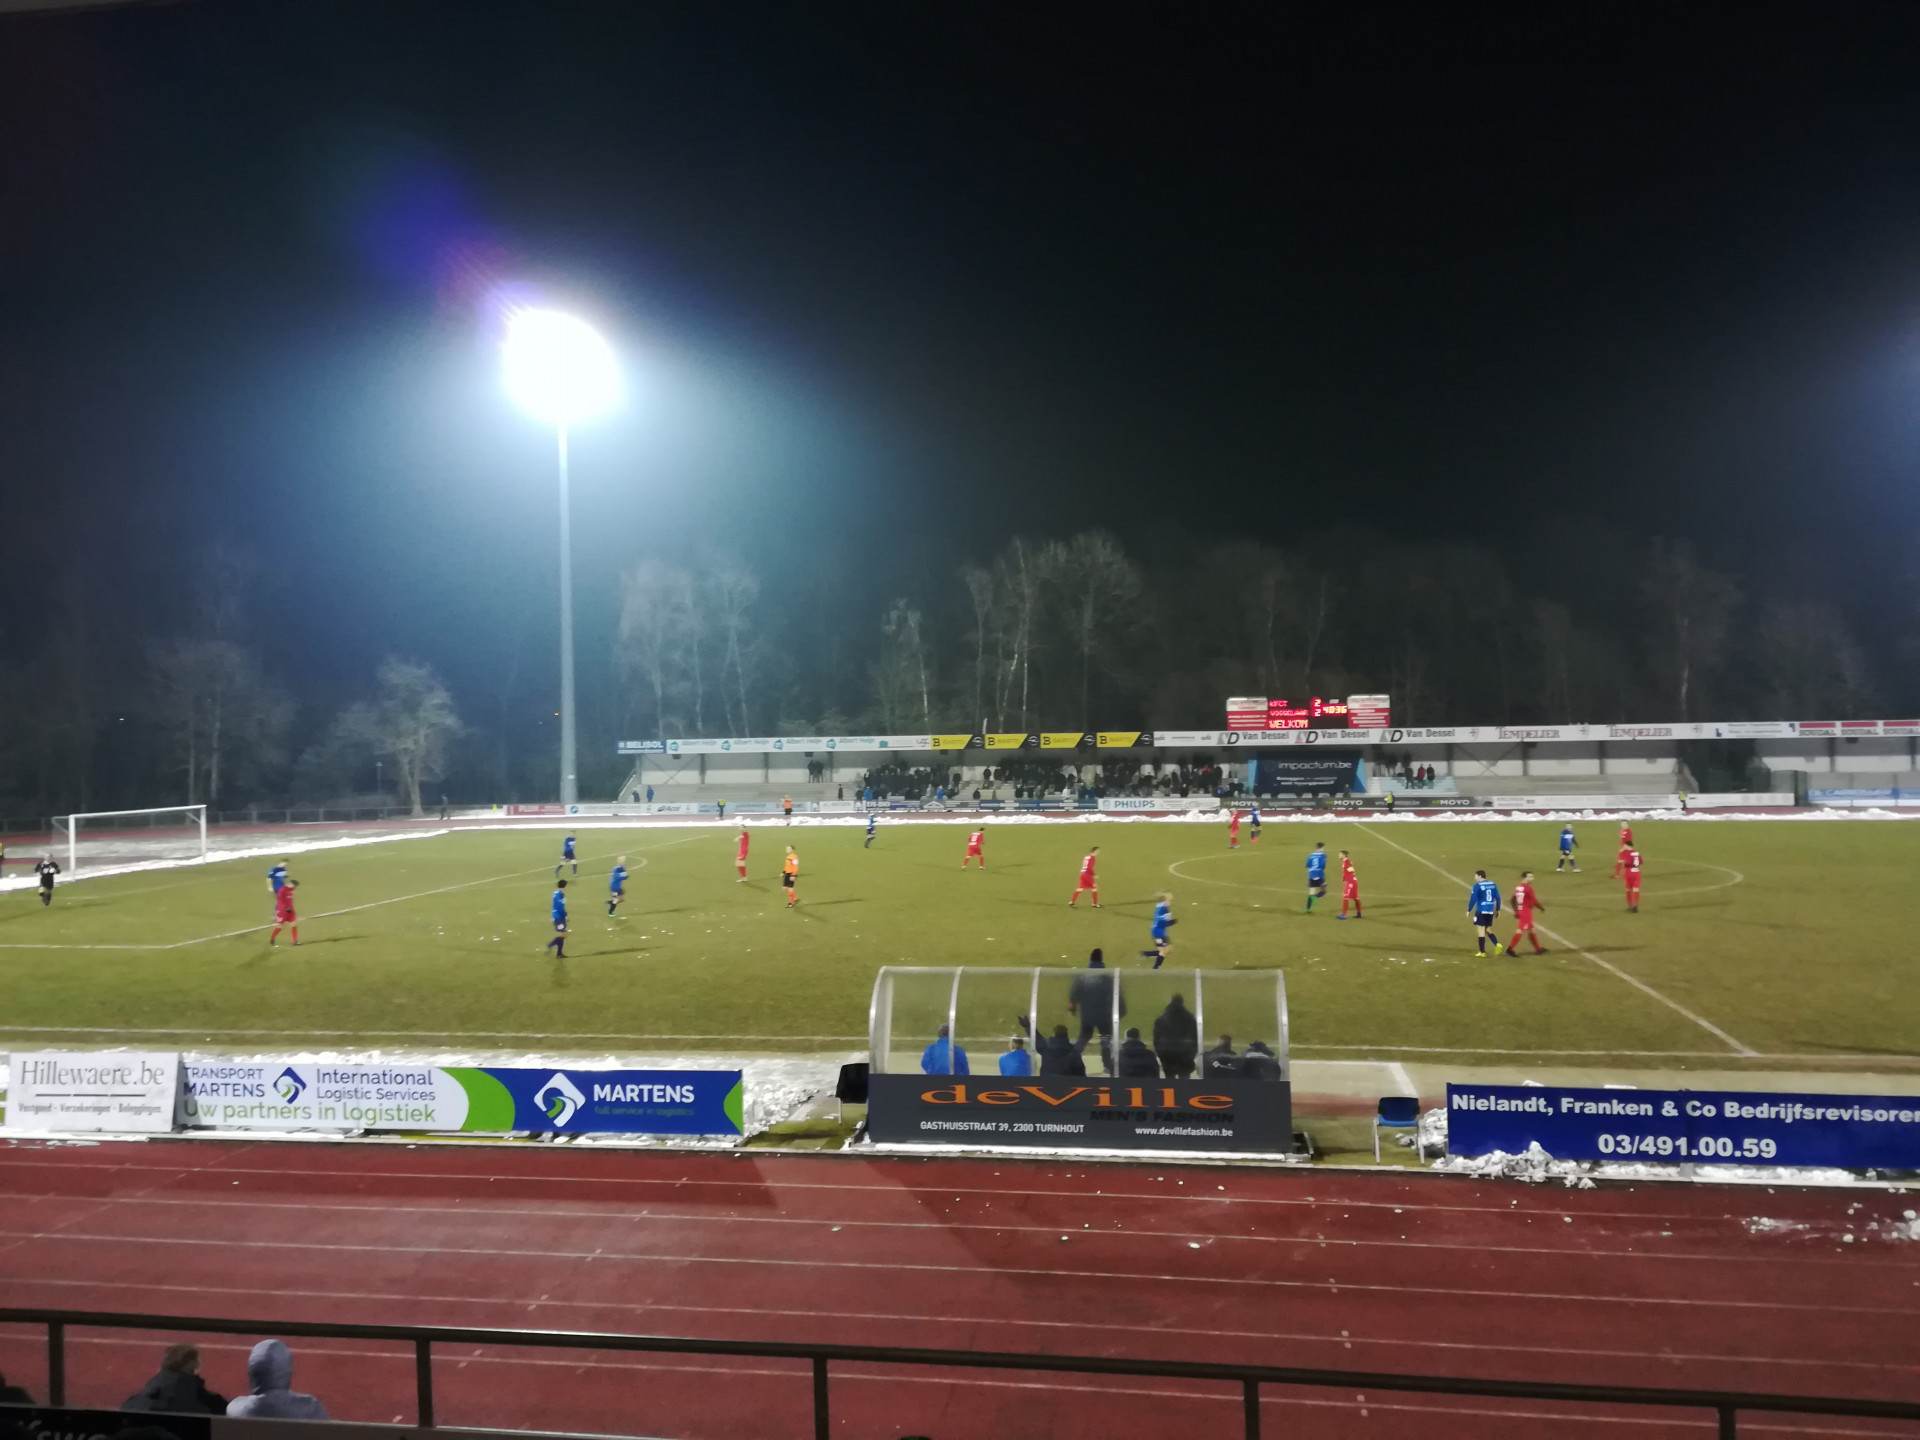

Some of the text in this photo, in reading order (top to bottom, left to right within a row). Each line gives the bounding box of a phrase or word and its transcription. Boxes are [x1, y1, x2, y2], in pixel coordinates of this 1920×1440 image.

[1314, 699, 1321, 707] 2
[1314, 709, 1321, 717] 2
[1268, 719, 1309, 729] WELKOM
[1242, 732, 1259, 740] Van
[1261, 731, 1290, 740] Dessel
[1340, 730, 1370, 738] Dessel
[1406, 730, 1423, 738] Van
[1425, 729, 1456, 737] Dessel
[1114, 800, 1155, 808] PHILIPS
[20, 1060, 165, 1086] Hillewaere.be
[184, 1067, 264, 1080] TRANSPORT
[317, 1069, 433, 1085] International
[184, 1083, 265, 1098] MARTENS
[317, 1087, 436, 1102] Logistic Services
[593, 1084, 695, 1104] MARTENS
[920, 1084, 1234, 1110] deVille
[1452, 1094, 1554, 1116] Nielandt,
[1560, 1097, 1653, 1116] Franken
[1661, 1100, 1679, 1117] &
[1685, 1100, 1717, 1117] Co
[184, 1100, 436, 1127] Uw partners in logistiek
[1090, 1111, 1234, 1124] MEN'S FASHION
[920, 1121, 1084, 1133] GASTHUISSTRAAT 39, 2300 TURNHOUT
[1135, 1126, 1234, 1137] www.devillefashion.be
[1597, 1134, 1777, 1159] 03/491.00.59
